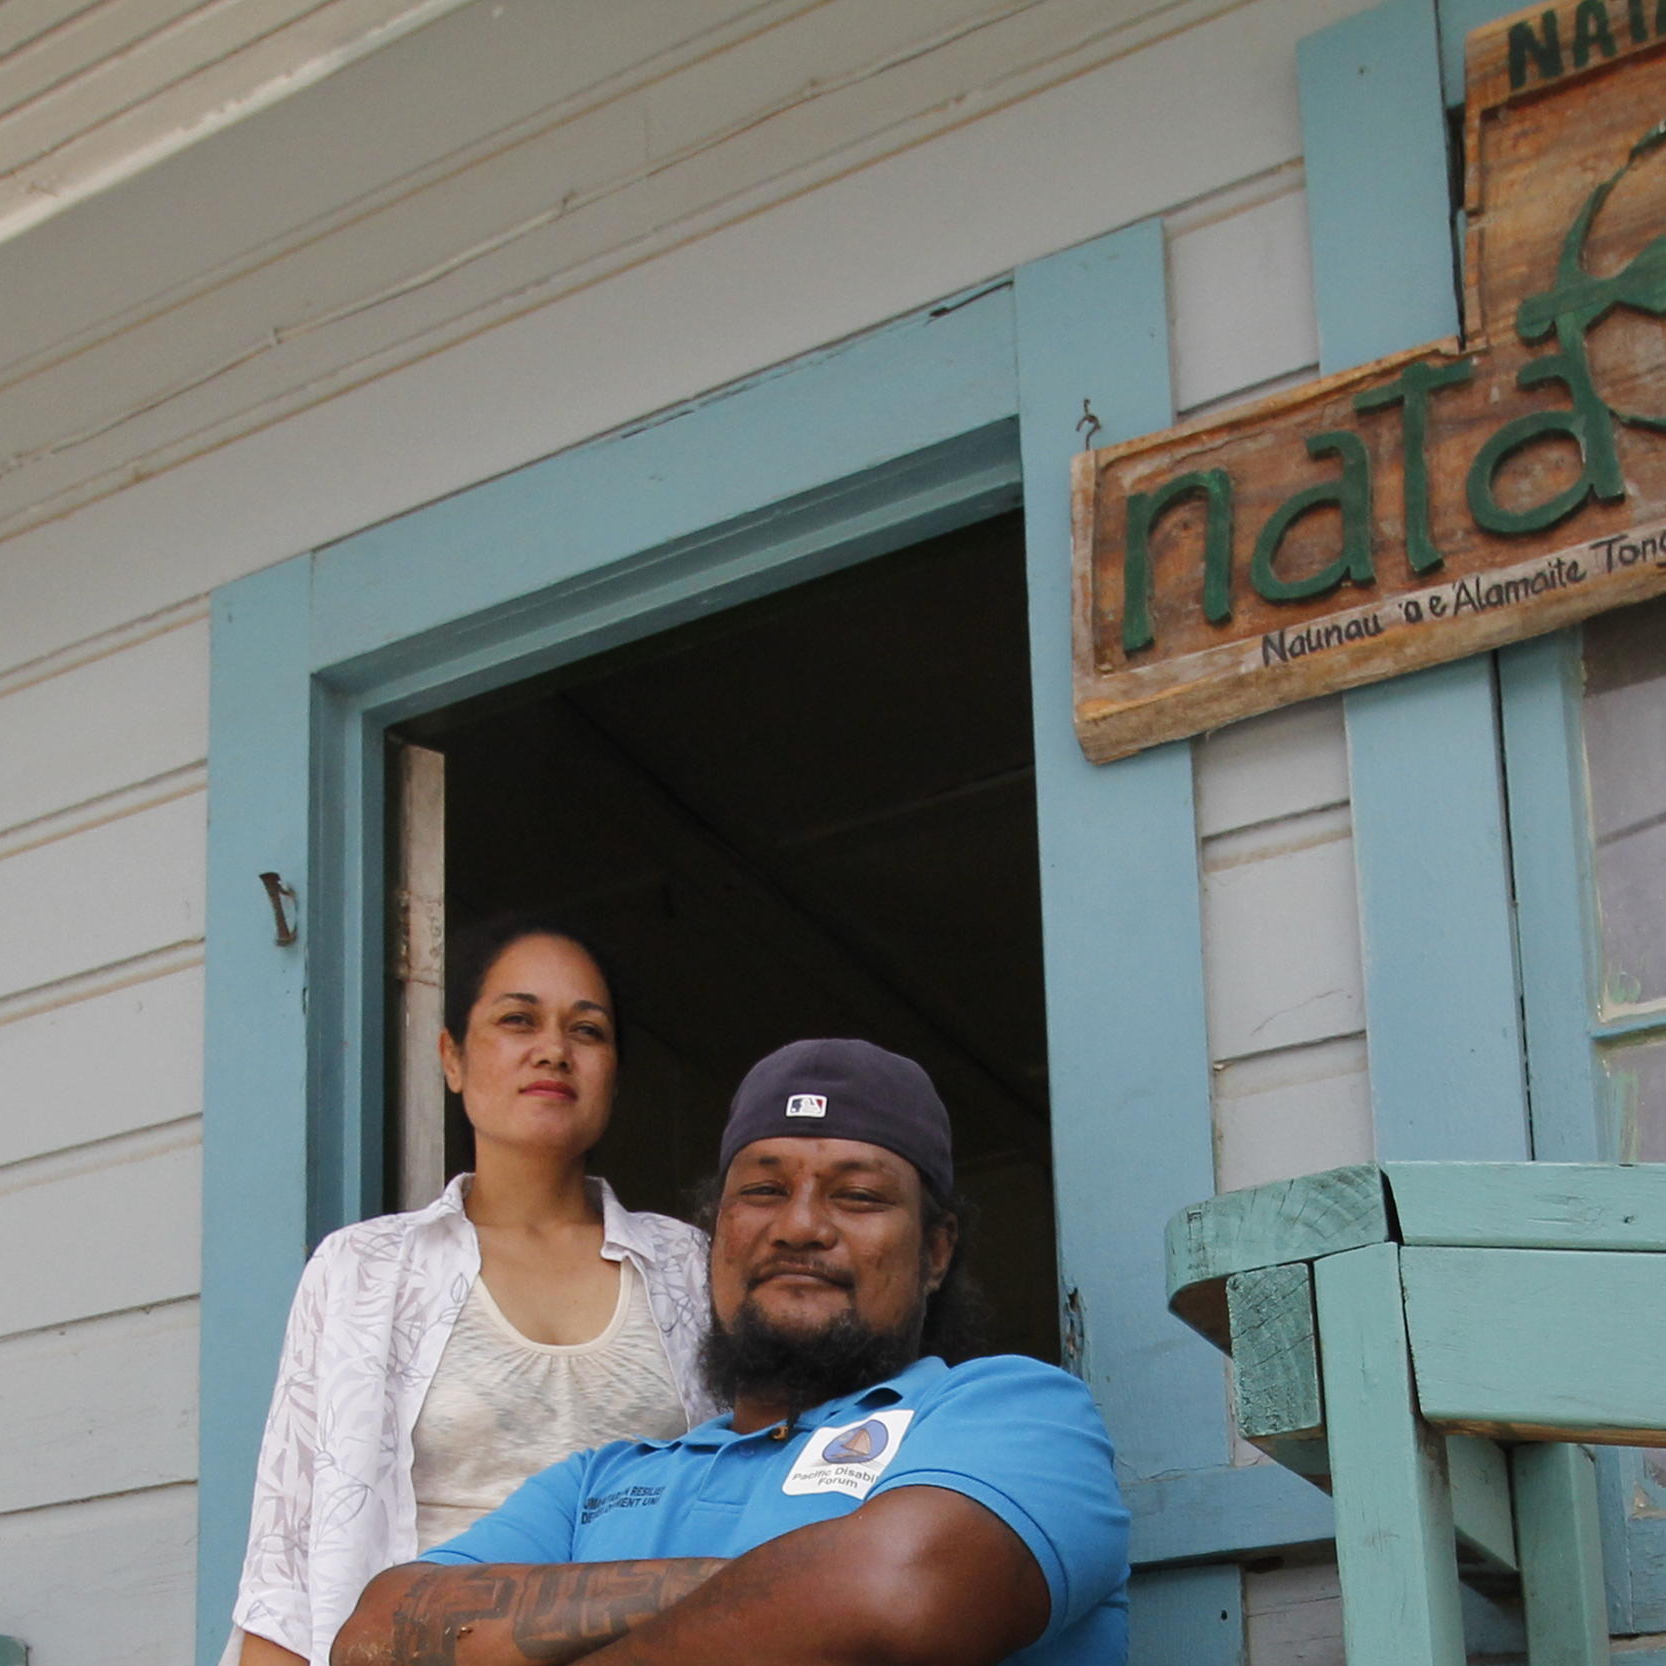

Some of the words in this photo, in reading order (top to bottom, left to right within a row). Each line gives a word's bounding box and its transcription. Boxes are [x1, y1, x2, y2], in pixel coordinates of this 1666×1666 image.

[1261, 613, 1383, 668] Naunau
[1429, 595, 1448, 618] e
[817, 1477, 859, 1489] Forum
